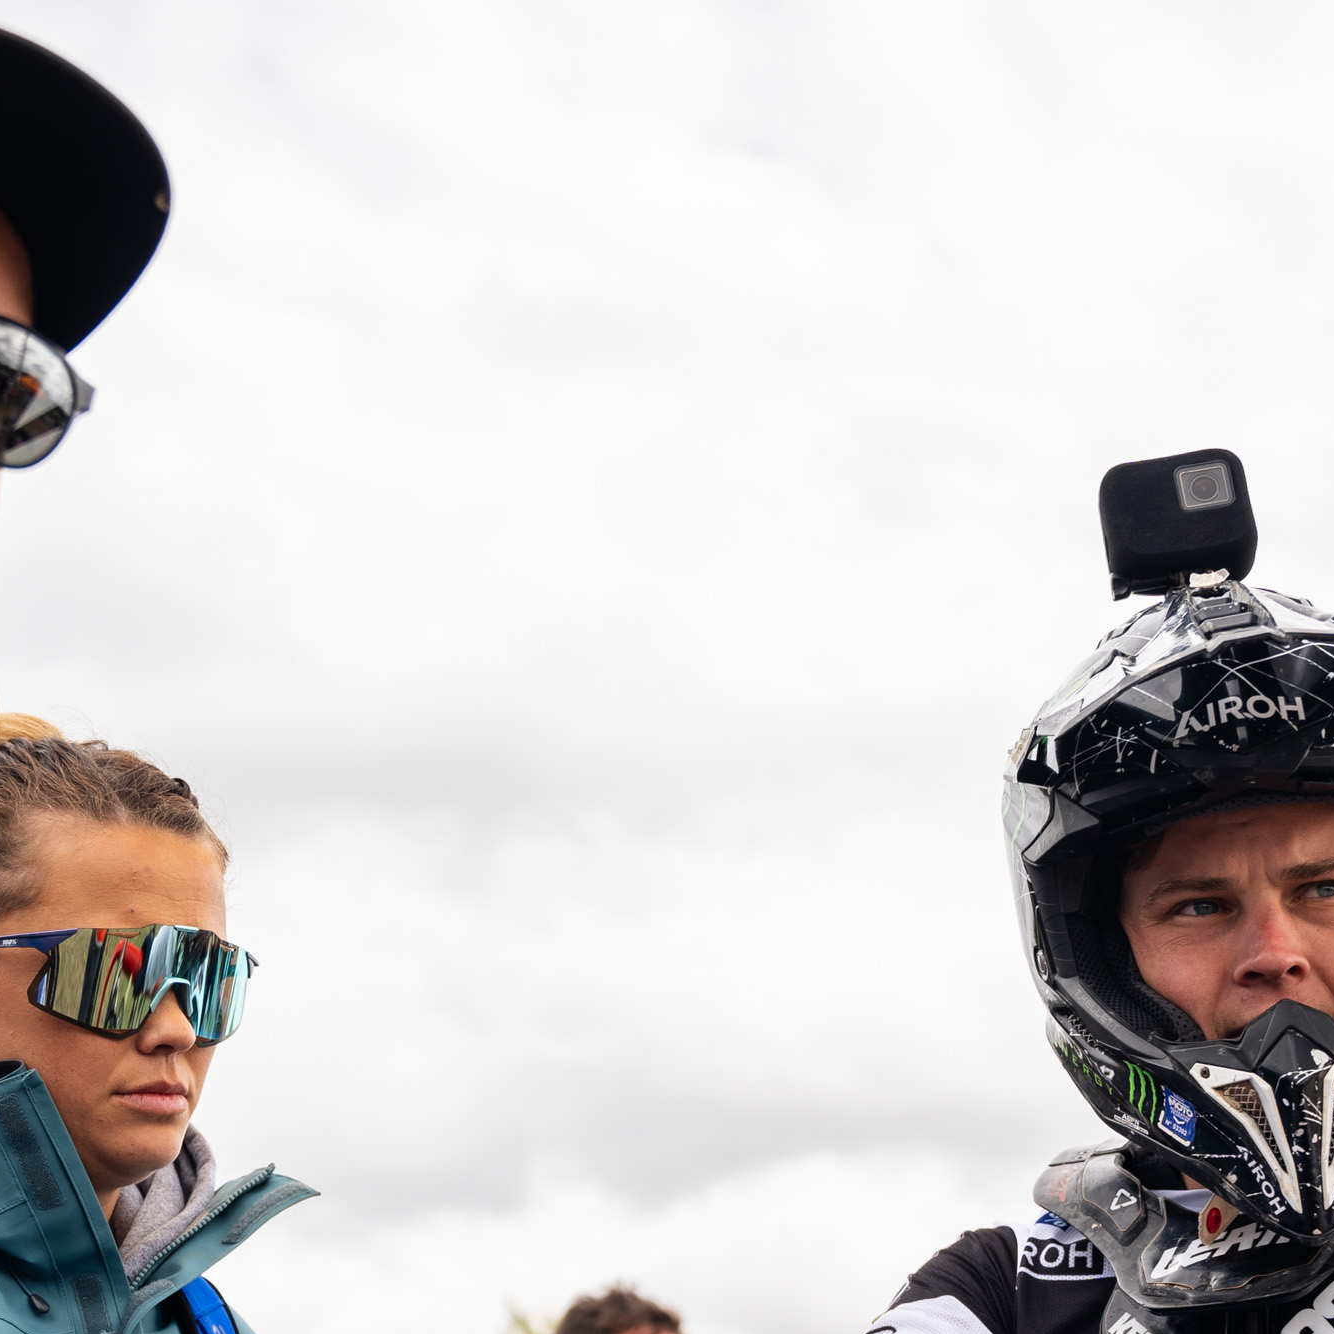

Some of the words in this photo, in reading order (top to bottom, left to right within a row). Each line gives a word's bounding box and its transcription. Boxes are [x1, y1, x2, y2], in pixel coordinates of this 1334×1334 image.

[1175, 694, 1307, 740] AIROH
[1235, 1144, 1287, 1216] AIROH
[1020, 1240, 1094, 1269] ROH
